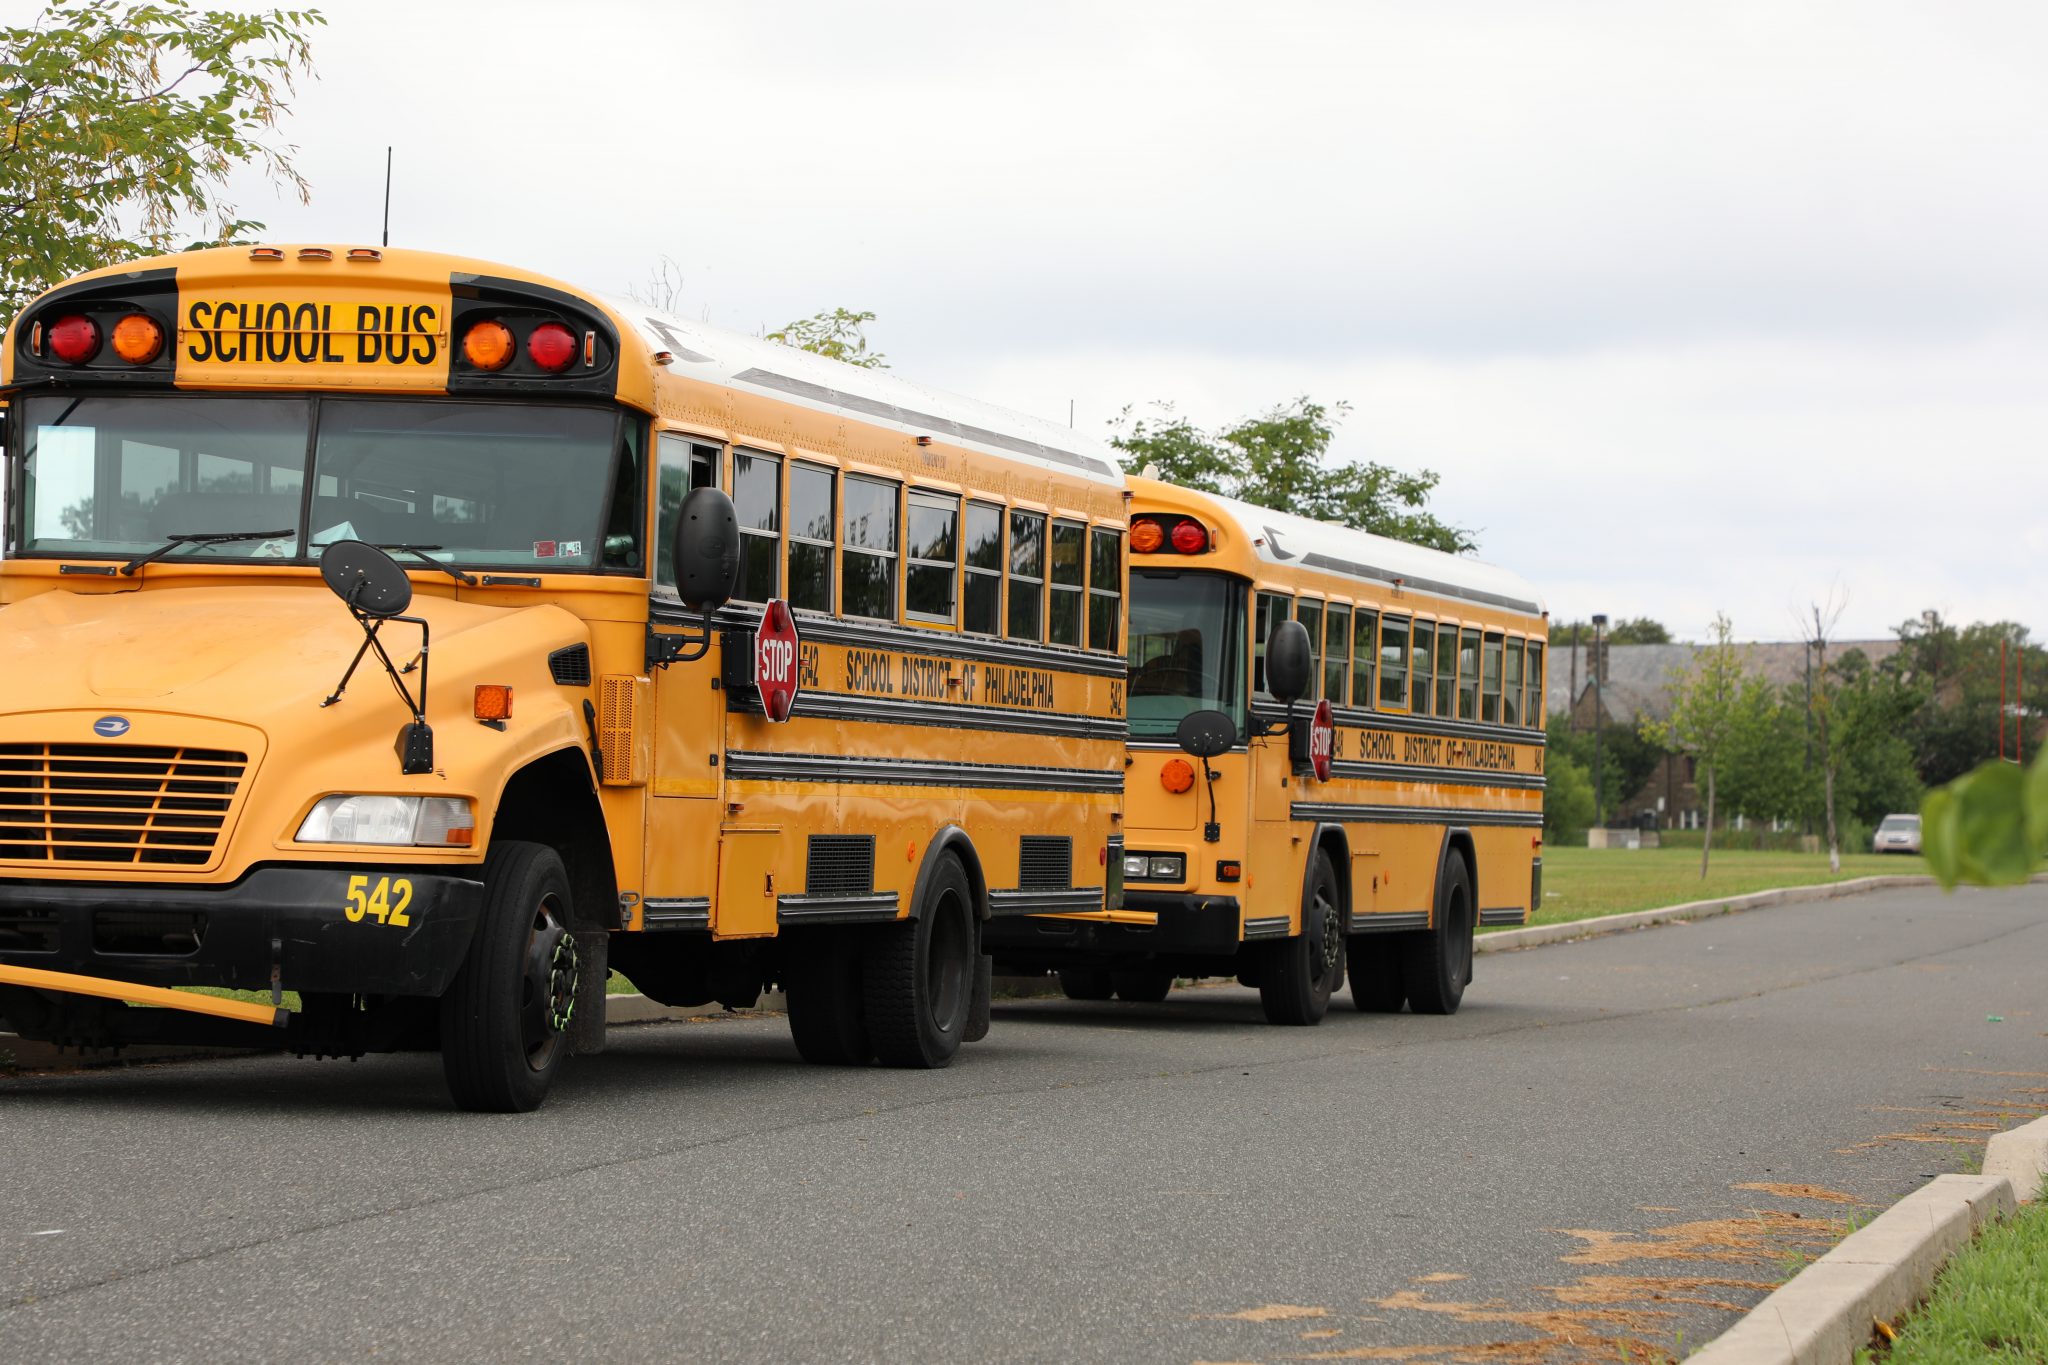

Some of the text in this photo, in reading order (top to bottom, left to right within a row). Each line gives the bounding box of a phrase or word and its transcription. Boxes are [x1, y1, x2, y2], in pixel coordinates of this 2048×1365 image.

[188, 301, 437, 365] SCHOOL BUS
[762, 638, 793, 683] STOP
[802, 645, 1122, 716] 542 SCHOOL DISTRICT OF PHILADELPHIA 542
[1314, 726, 1331, 757] STOP
[1360, 730, 1396, 761] SCHOOL
[1404, 735, 1442, 765] DISTRICT
[1446, 739, 1457, 766] OF
[1461, 740, 1516, 771] PHILADELPHIA
[344, 874, 413, 928] 542
